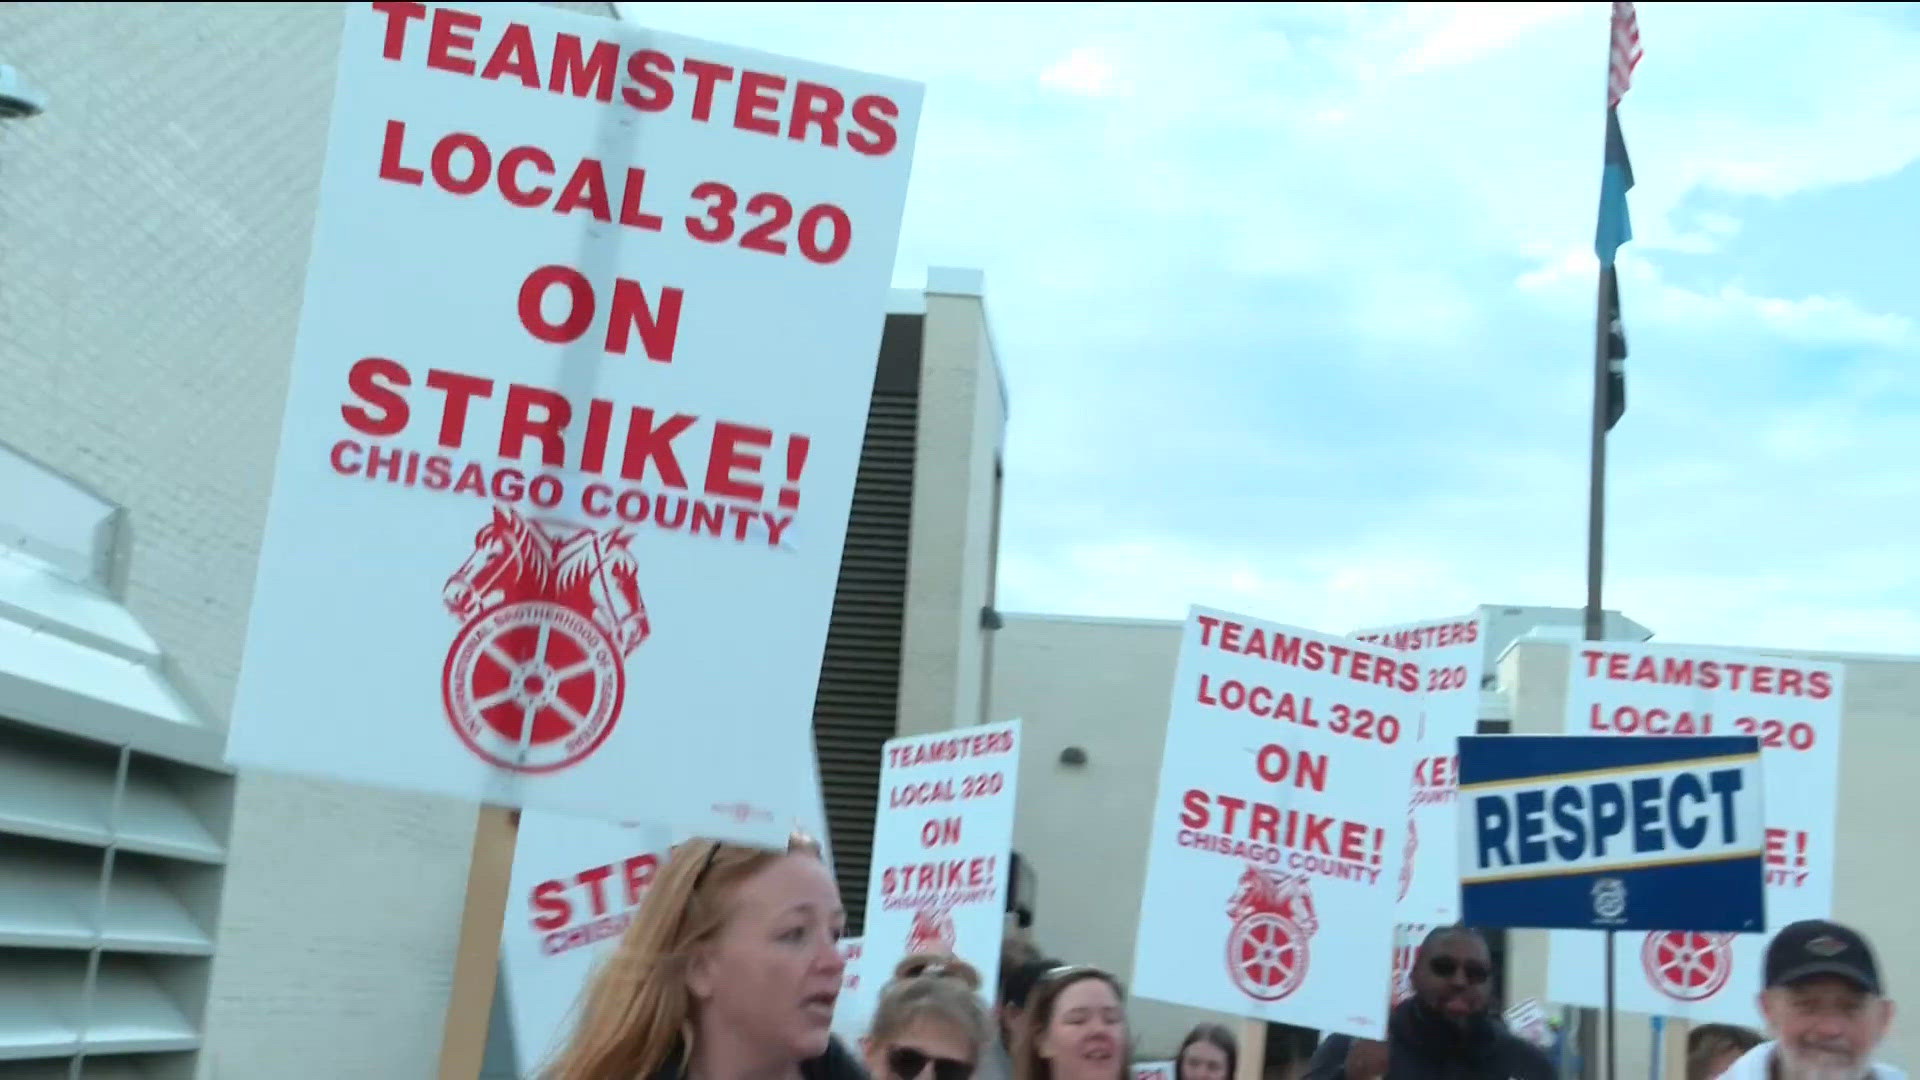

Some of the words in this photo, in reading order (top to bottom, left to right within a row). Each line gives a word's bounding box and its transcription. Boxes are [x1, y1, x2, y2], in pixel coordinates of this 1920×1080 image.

[372, 2, 899, 156] TEAMSTERS
[379, 120, 663, 232] LOCAL
[685, 182, 852, 264] 320
[518, 265, 684, 363] ON
[340, 357, 811, 510] STRIKE!
[330, 439, 563, 508] CHISAGO
[581, 483, 795, 546] COUNTY
[1197, 615, 1420, 692] TEAMSTERS
[1357, 620, 1478, 651] AMSTERS
[1196, 674, 1318, 729] LOCAL
[1328, 704, 1400, 744] 320
[1582, 650, 1832, 699] TEAMSTERS
[889, 729, 1014, 769] TEAMSTERS
[1257, 743, 1328, 792] ON
[890, 779, 955, 809] LOCAL
[962, 771, 1005, 799] 320
[1476, 768, 1742, 868] RESPECT
[921, 815, 963, 849] ON
[1178, 829, 1281, 865] CHISAGO
[1288, 852, 1382, 884] COUNTY
[1180, 789, 1385, 865] STRIKE!
[882, 855, 996, 896] STRIKE!
